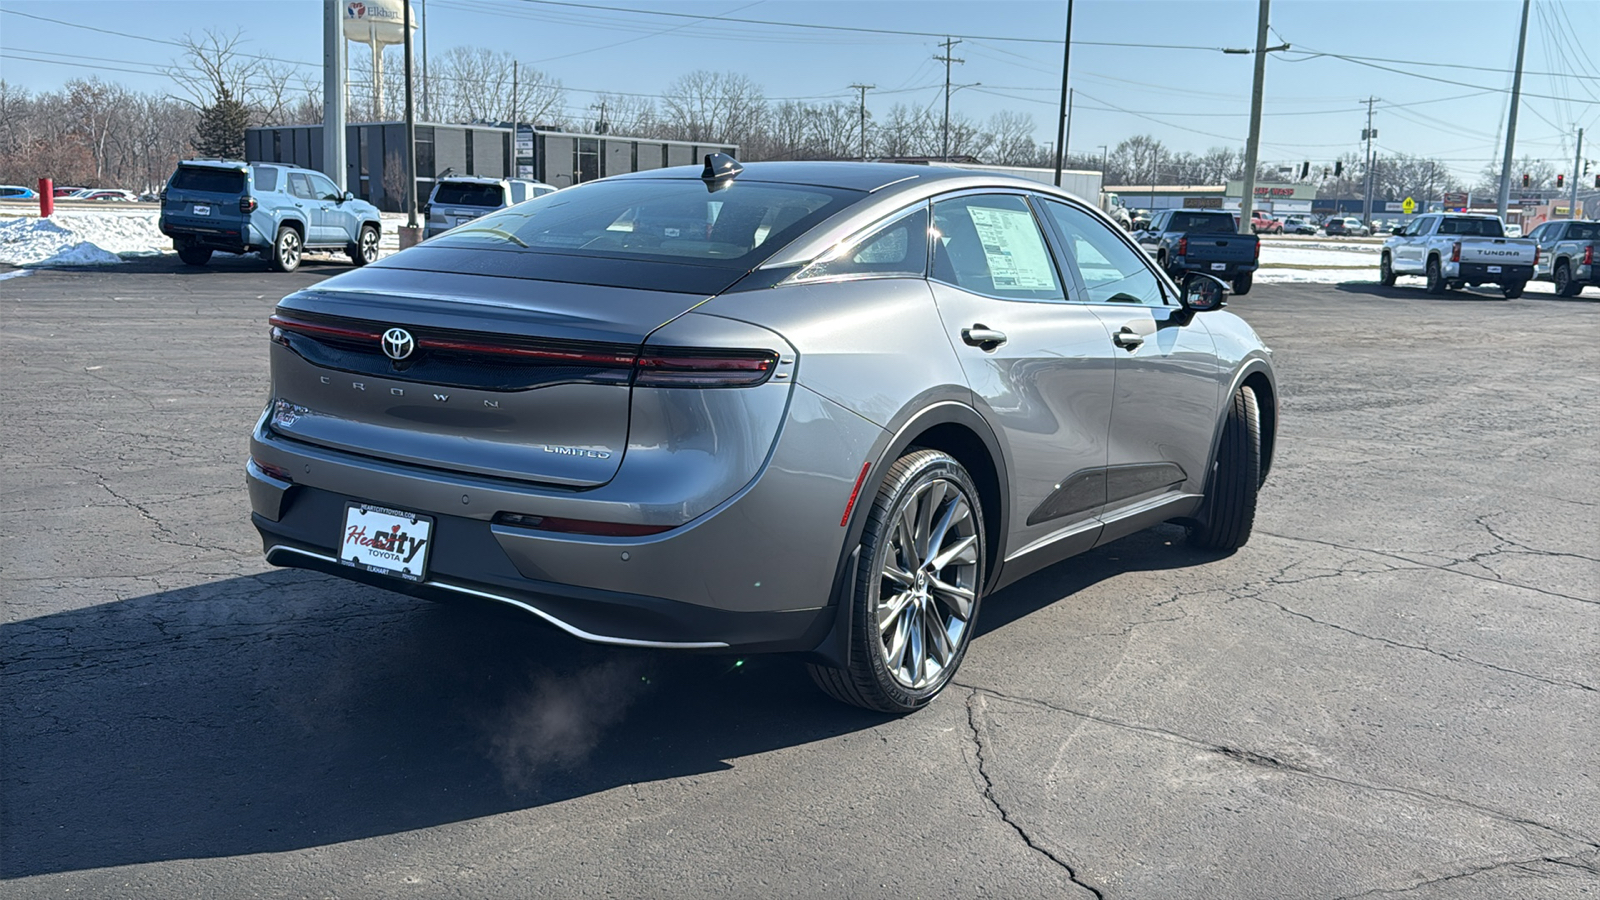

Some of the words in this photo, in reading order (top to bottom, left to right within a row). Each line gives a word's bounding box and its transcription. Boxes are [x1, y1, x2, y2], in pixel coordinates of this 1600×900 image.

[1272, 188, 1294, 196] WASH
[1477, 249, 1520, 257] TUNDRA
[320, 376, 499, 408] CROWN
[544, 445, 611, 459] LIMITED
[361, 504, 416, 518] HEARTCITYTOYOTA.COM
[368, 549, 401, 561] TOYOTA
[366, 565, 390, 575] ELKHART
